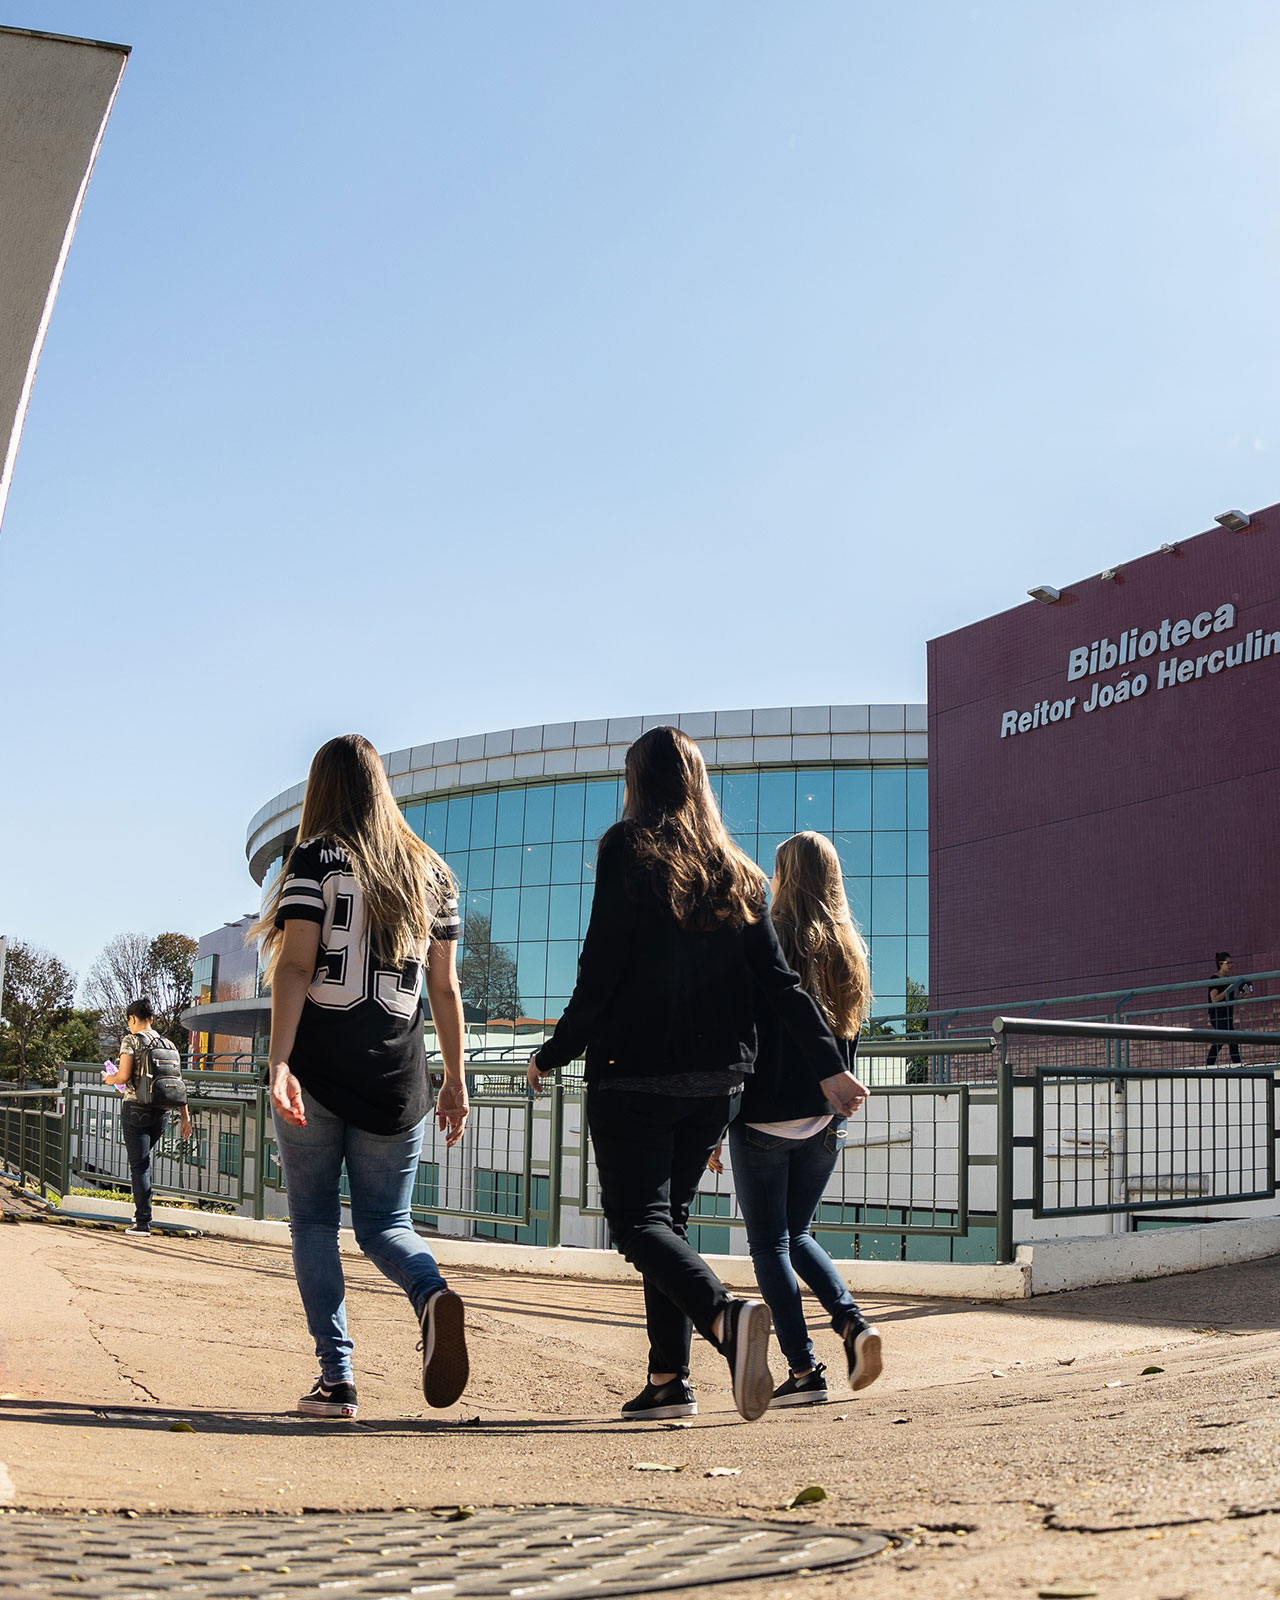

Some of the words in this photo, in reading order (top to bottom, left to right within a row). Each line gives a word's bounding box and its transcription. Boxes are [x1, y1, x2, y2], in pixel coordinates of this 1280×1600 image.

[1067, 602, 1237, 682] Biblioteca
[1000, 696, 1076, 739] Reitor
[1083, 670, 1149, 714] João
